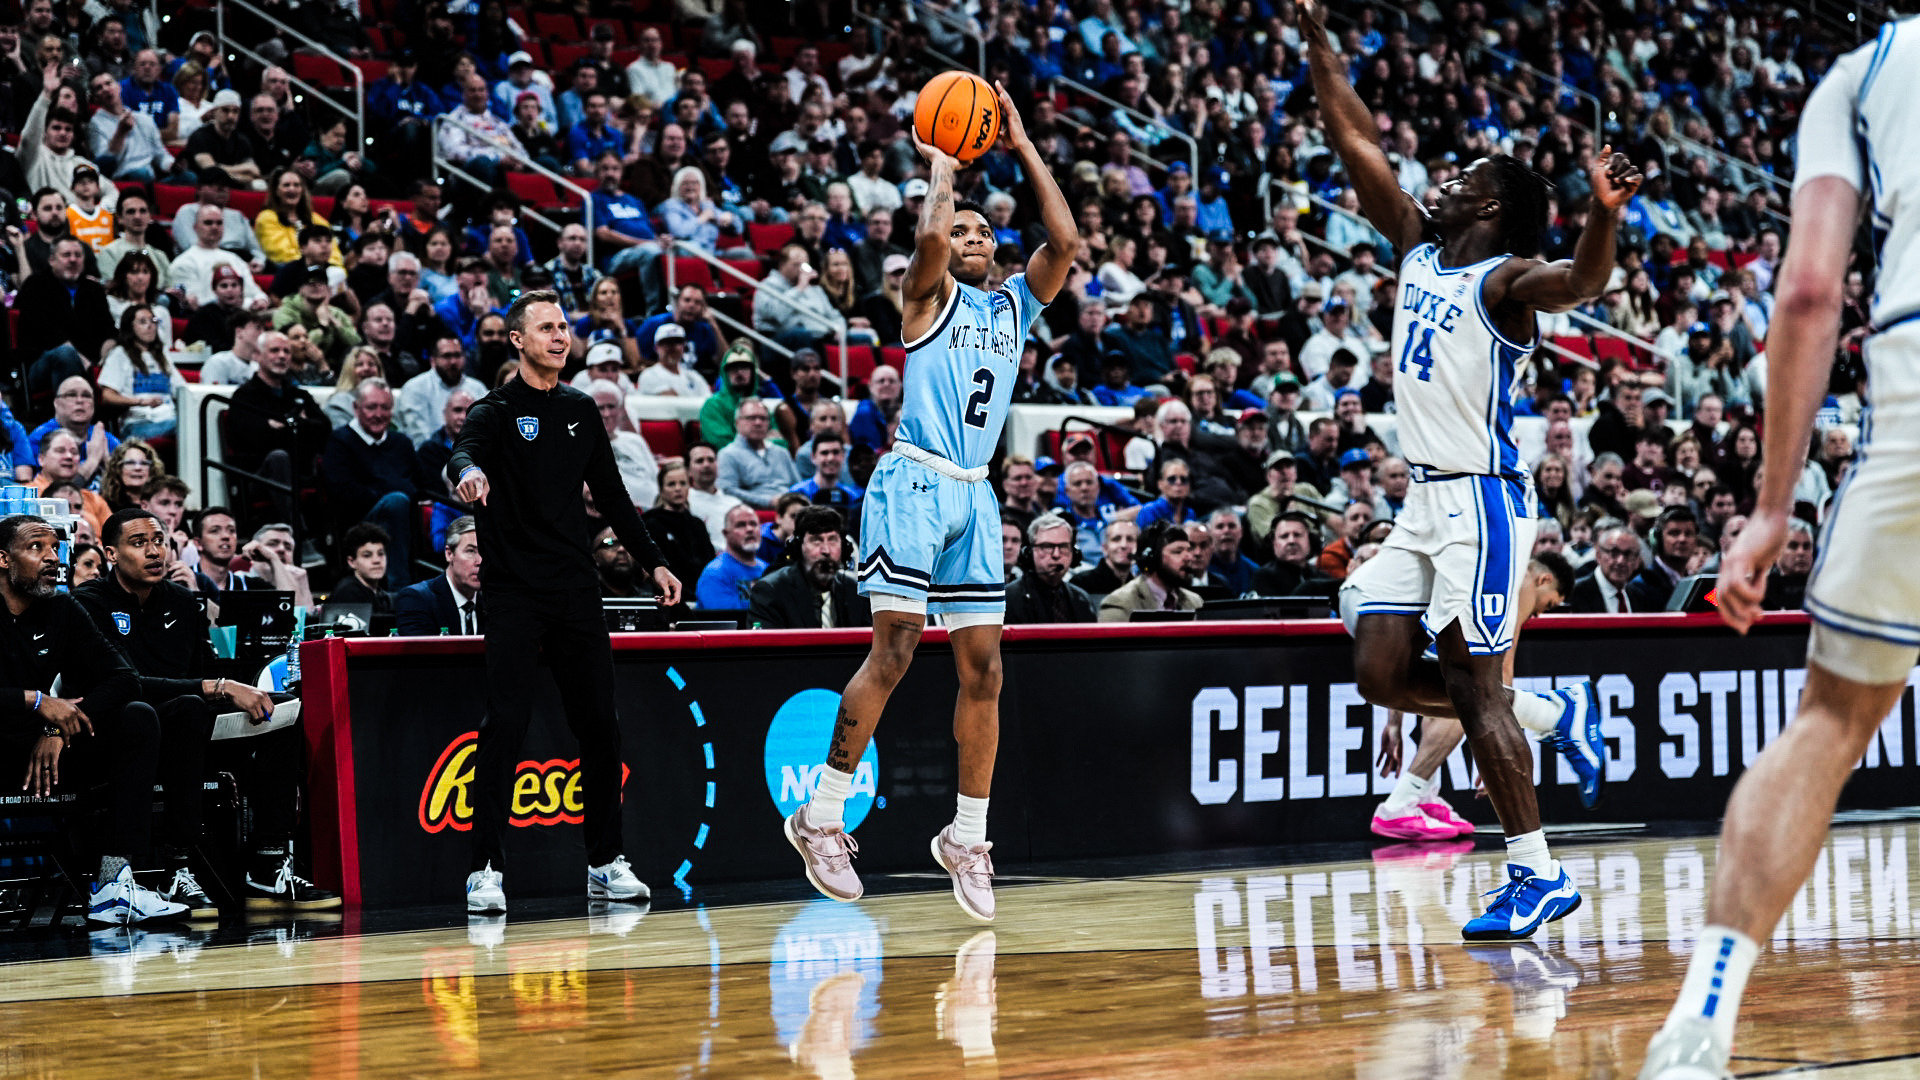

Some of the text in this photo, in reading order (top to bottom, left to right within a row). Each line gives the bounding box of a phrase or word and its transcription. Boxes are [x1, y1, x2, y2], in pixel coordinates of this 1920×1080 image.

[972, 107, 993, 149] NCAA
[948, 324, 971, 350] MT.
[974, 326, 990, 351] ST.
[1399, 320, 1436, 382] 14
[964, 366, 996, 431] 2
[1481, 593, 1505, 617] D
[1191, 664, 1920, 805] CELEBTS STUN
[6, 796, 22, 804] ROAD
[22, 795, 30, 803] TO
[61, 793, 77, 802] FOUR
[203, 781, 219, 790] FOUR
[780, 761, 876, 802] NCA
